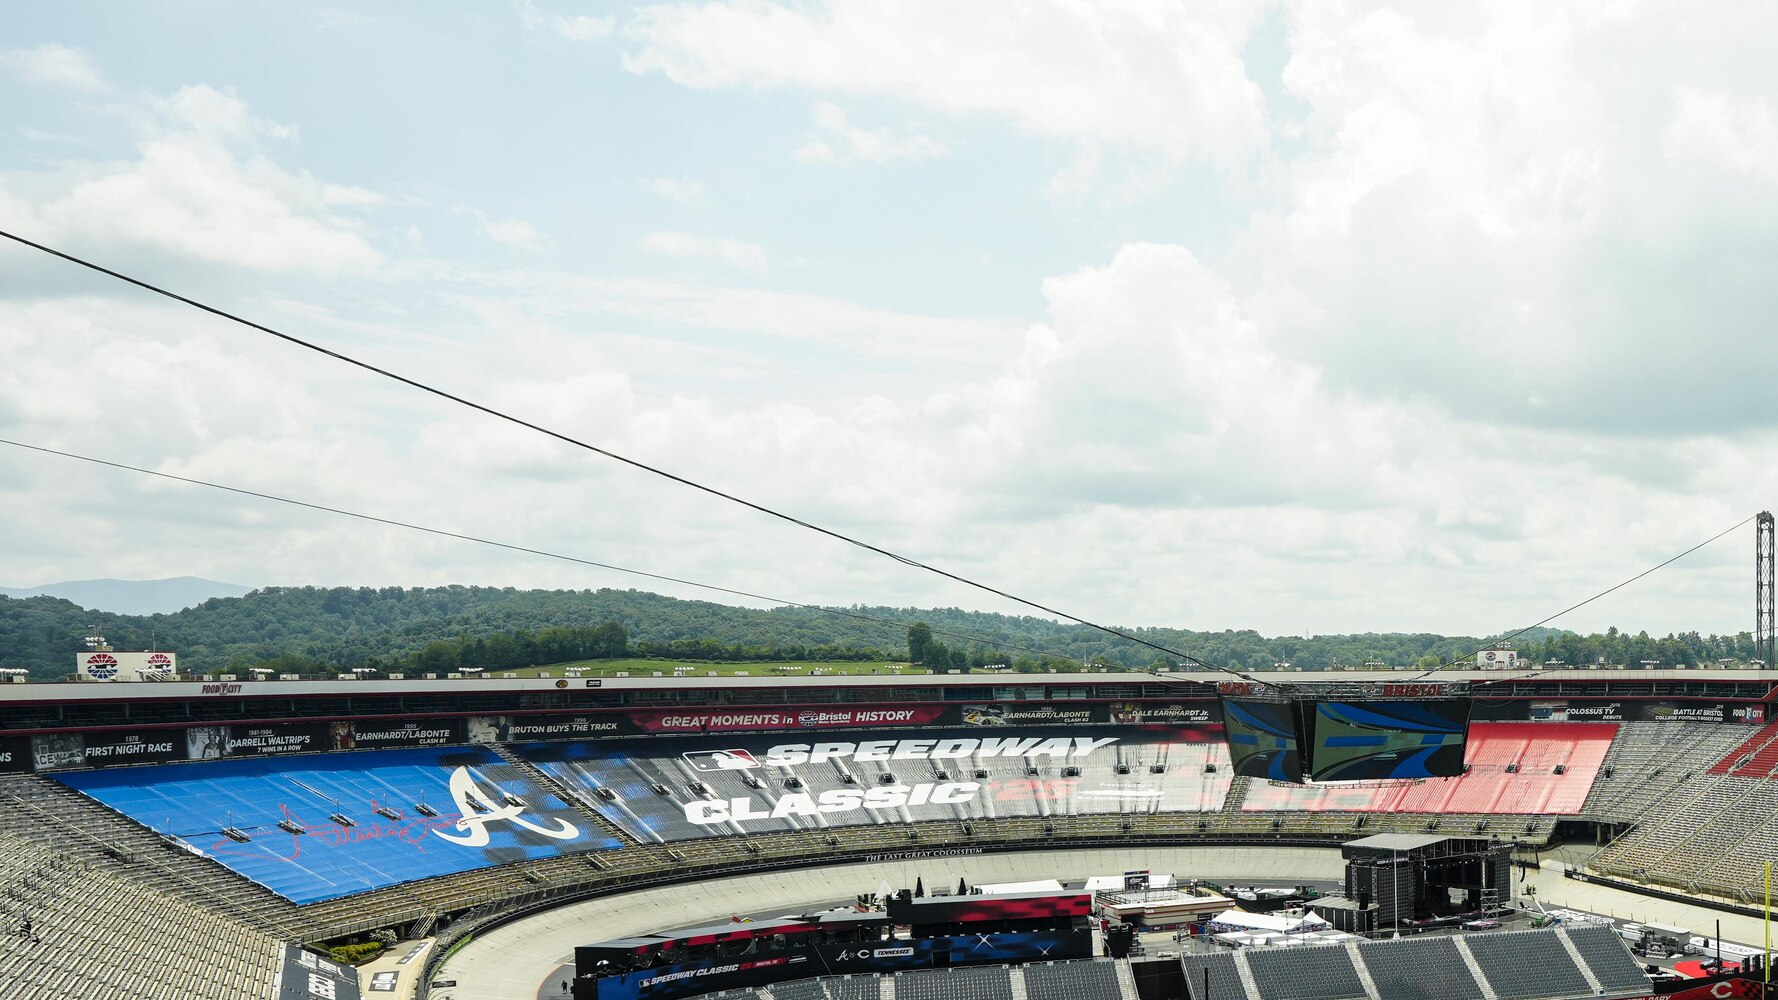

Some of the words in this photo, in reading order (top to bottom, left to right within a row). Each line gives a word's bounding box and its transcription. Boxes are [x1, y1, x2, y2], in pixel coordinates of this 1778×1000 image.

[202, 684, 220, 694] FOOD
[227, 684, 242, 694] CITY
[1382, 684, 1442, 696] BRISTOL
[818, 712, 851, 721] Bristol
[855, 710, 914, 722] HISTORY
[1004, 711, 1090, 719] EARNHARDT/LABONTE
[1153, 709, 1199, 717] EARNHARDT
[1733, 709, 1745, 717] FOOD
[1752, 709, 1763, 718] CITY
[661, 715, 708, 727] GREAT
[711, 714, 779, 726] MOMENTS
[783, 715, 793, 724] in
[509, 725, 544, 734] BRUTON
[546, 724, 570, 733] BUYS
[571, 723, 588, 732] THE
[590, 722, 617, 731] TRACK
[355, 729, 450, 741] EARNHARDT/LABONTE
[230, 737, 267, 748] DARRELL
[267, 735, 310, 746] WALTRIP'S
[85, 746, 114, 757] FIRST
[115, 744, 146, 755] NIGHT
[148, 742, 172, 753] RACE
[767, 737, 1121, 766] SPEEDWAY
[684, 782, 981, 825] CLASSIC
[905, 851, 931, 859] GREAT
[933, 848, 983, 857] COLOSSEUM
[650, 970, 697, 985] SPEEDWAY
[696, 964, 739, 977] CLASSIC
[308, 972, 336, 1000] GEICO
